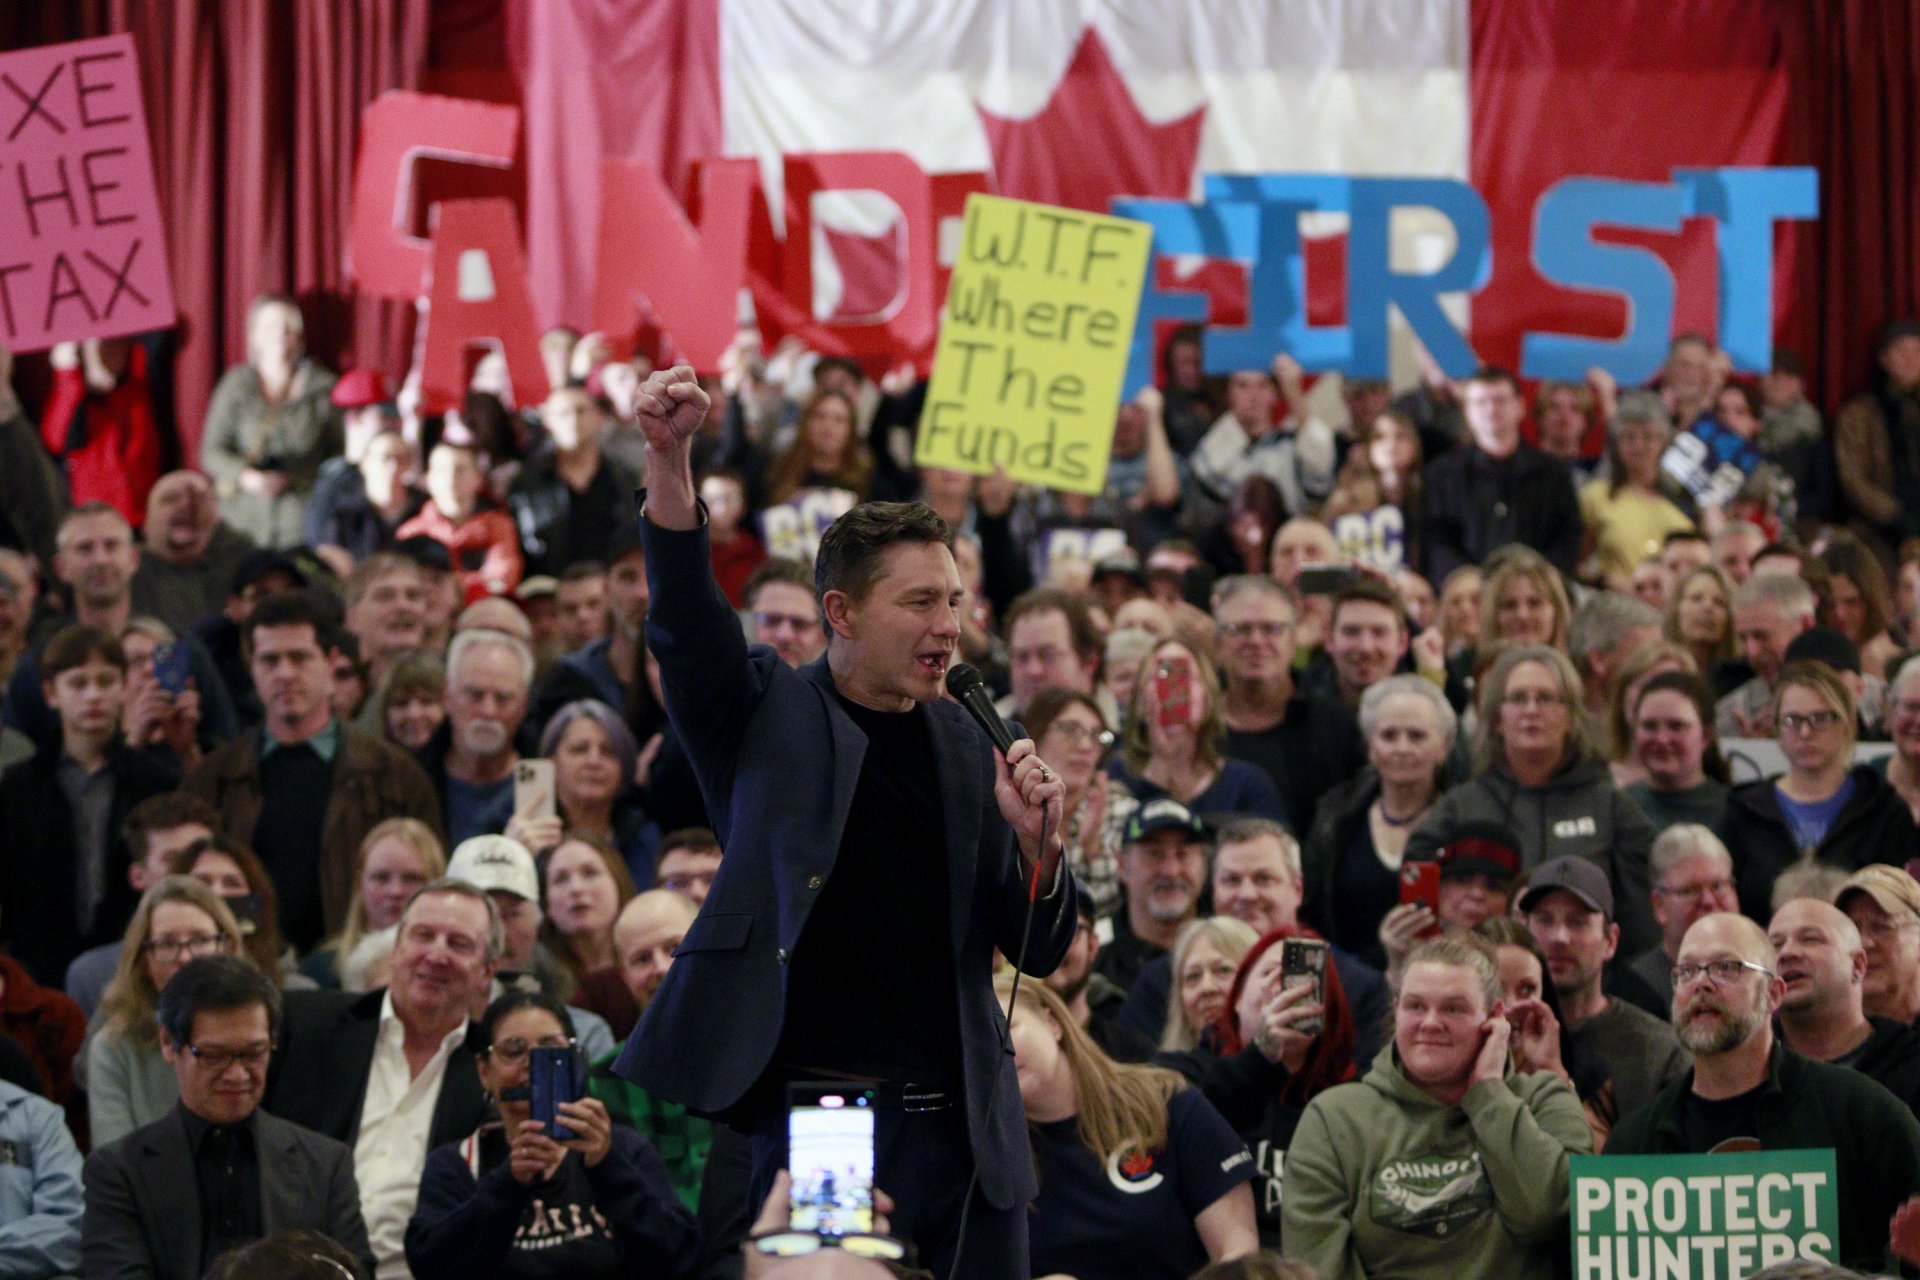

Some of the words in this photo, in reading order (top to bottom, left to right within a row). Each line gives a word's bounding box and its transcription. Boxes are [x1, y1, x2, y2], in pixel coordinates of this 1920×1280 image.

[0, 146, 137, 237] HE
[0, 238, 150, 338] TAX
[950, 271, 1119, 350] Where
[1110, 165, 1821, 406] FIRST
[950, 339, 1086, 416] The
[924, 400, 1090, 482] Funds
[1576, 1171, 1828, 1233] PROTECT
